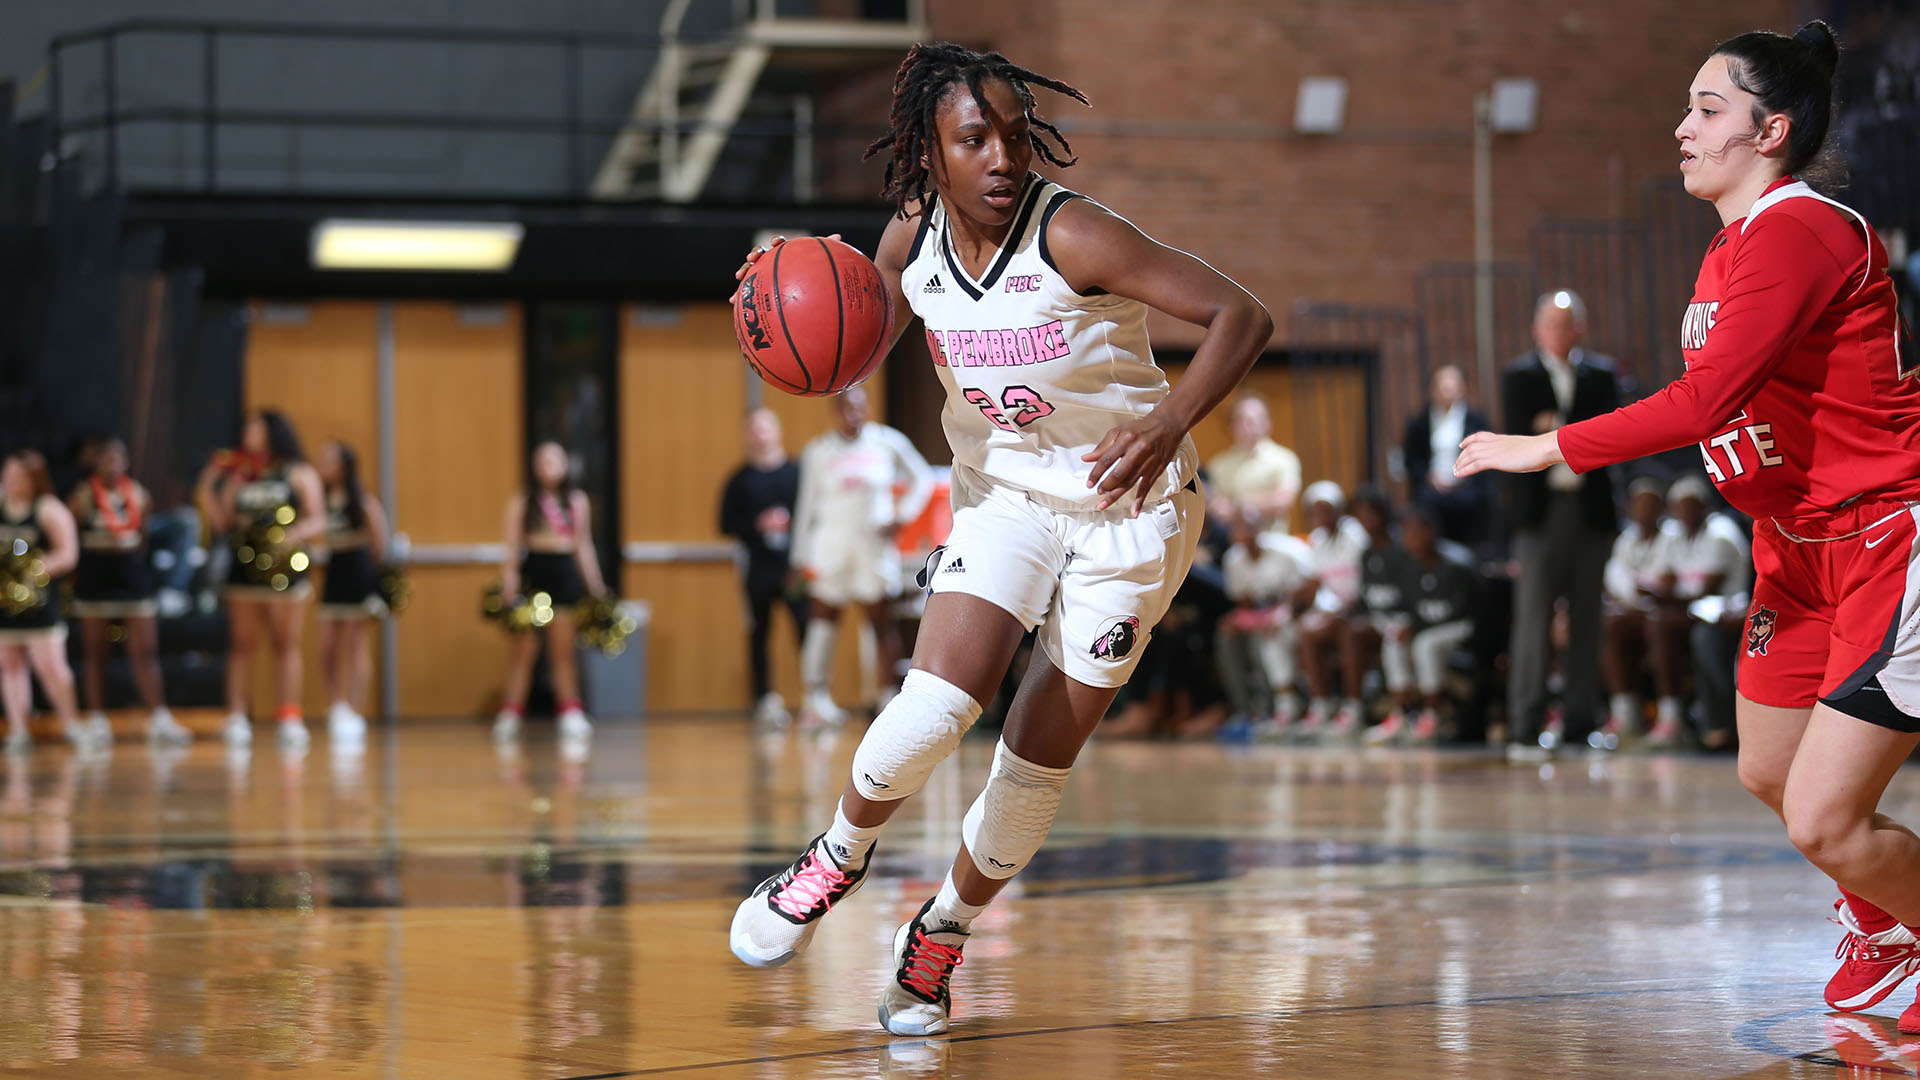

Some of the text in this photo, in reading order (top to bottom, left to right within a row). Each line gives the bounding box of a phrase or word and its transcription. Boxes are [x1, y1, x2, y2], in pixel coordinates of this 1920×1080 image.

[923, 285, 946, 294] adidas
[1005, 274, 1043, 293] PBC
[742, 272, 771, 351] NCAA
[947, 319, 1071, 367] PEMBROKE
[963, 385, 1056, 439] 23
